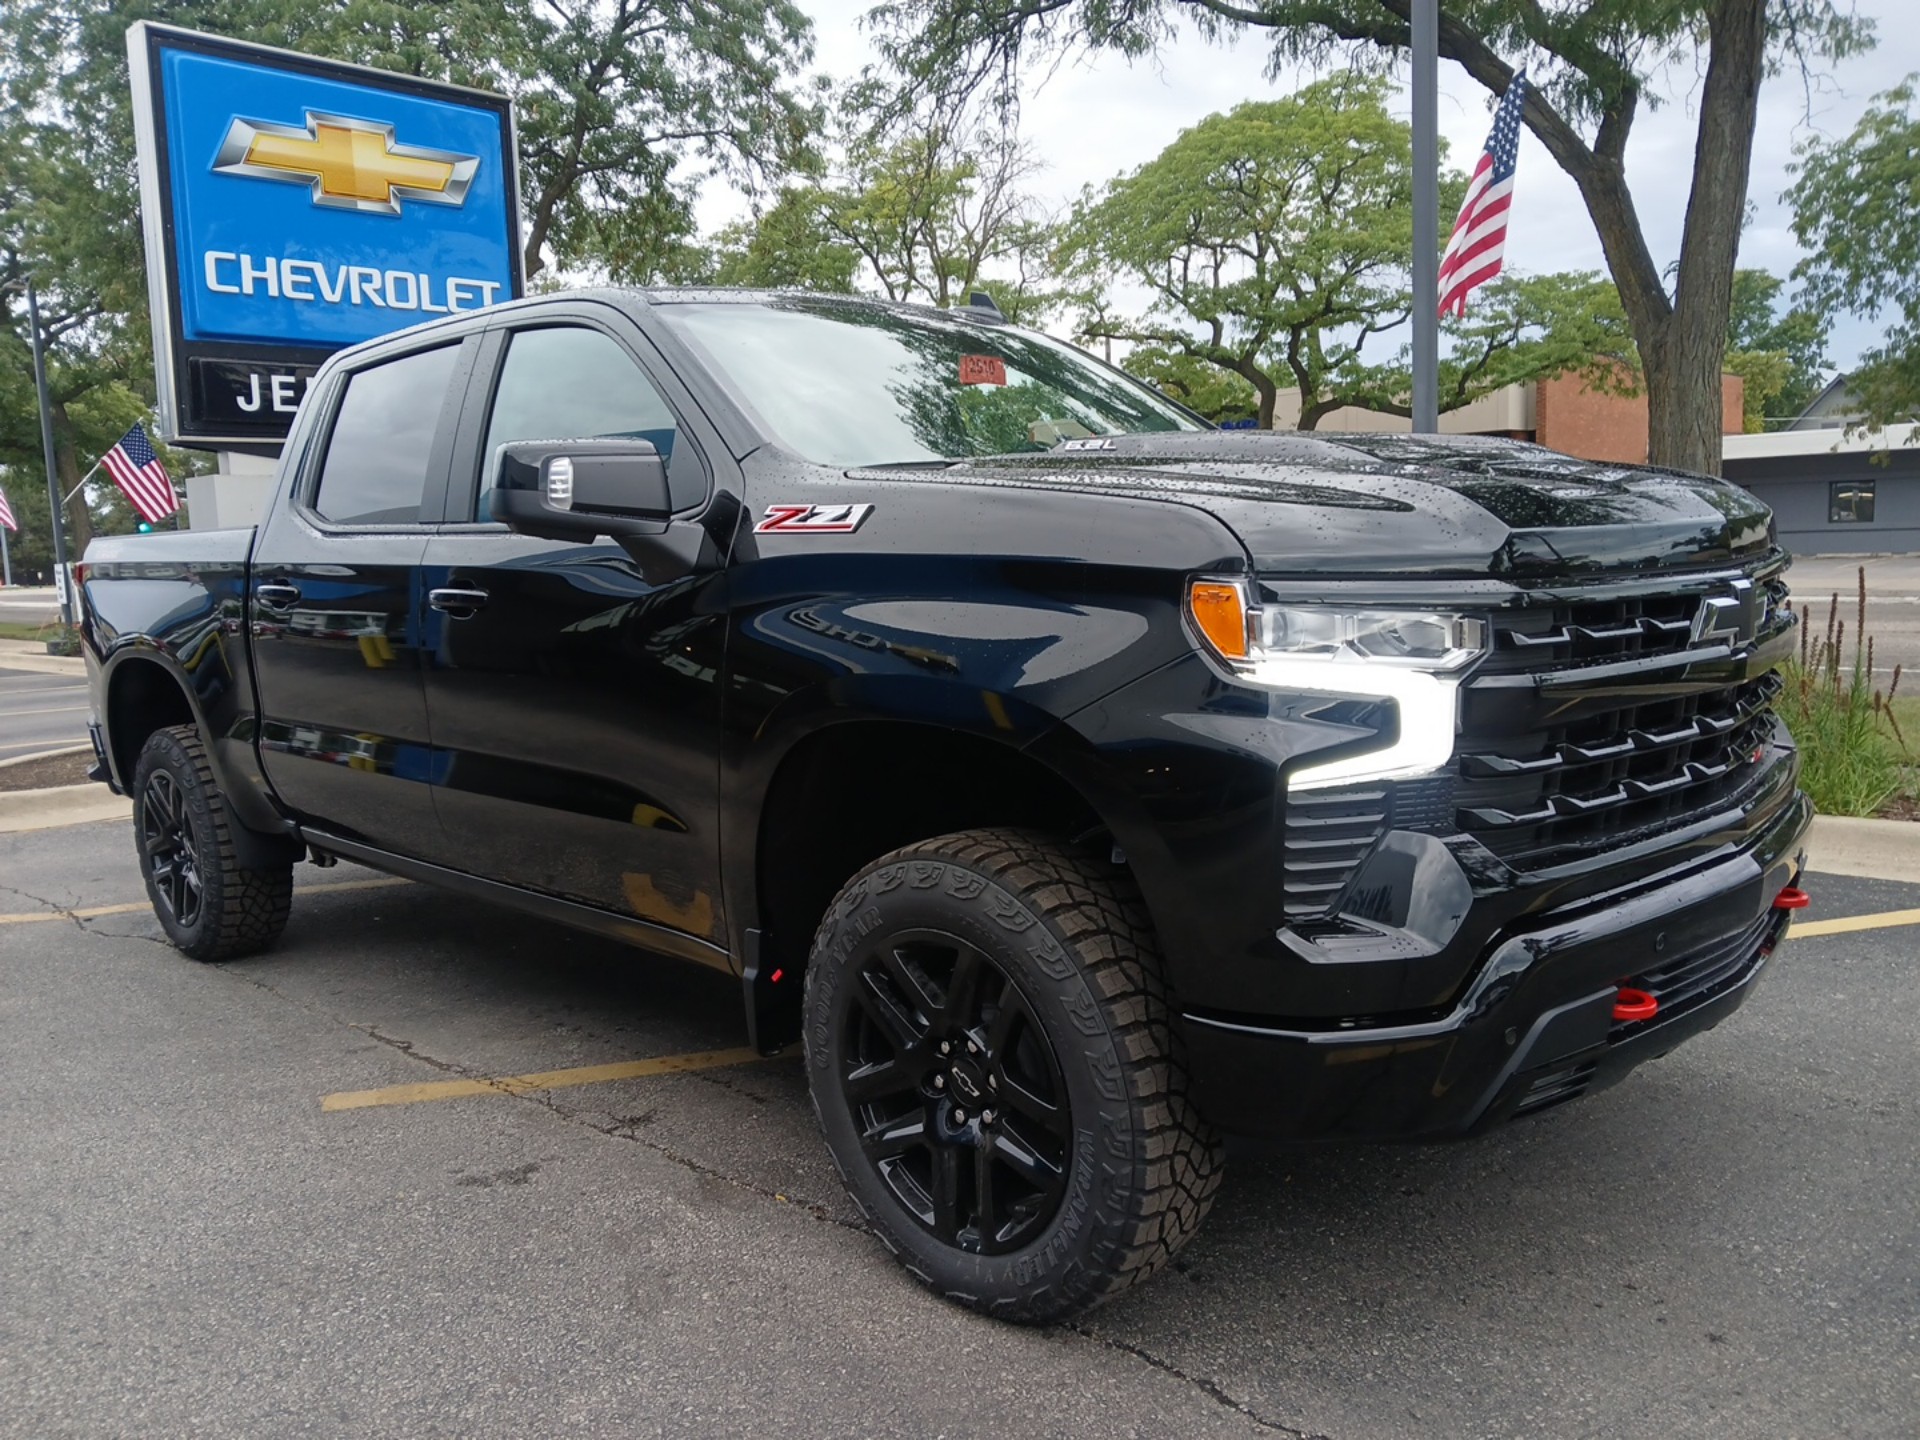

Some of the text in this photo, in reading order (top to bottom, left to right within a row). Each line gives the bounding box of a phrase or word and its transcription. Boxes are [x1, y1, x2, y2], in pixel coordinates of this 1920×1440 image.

[204, 250, 500, 314] CHEVROLET
[236, 373, 316, 412] JE
[753, 503, 874, 534] Z71
